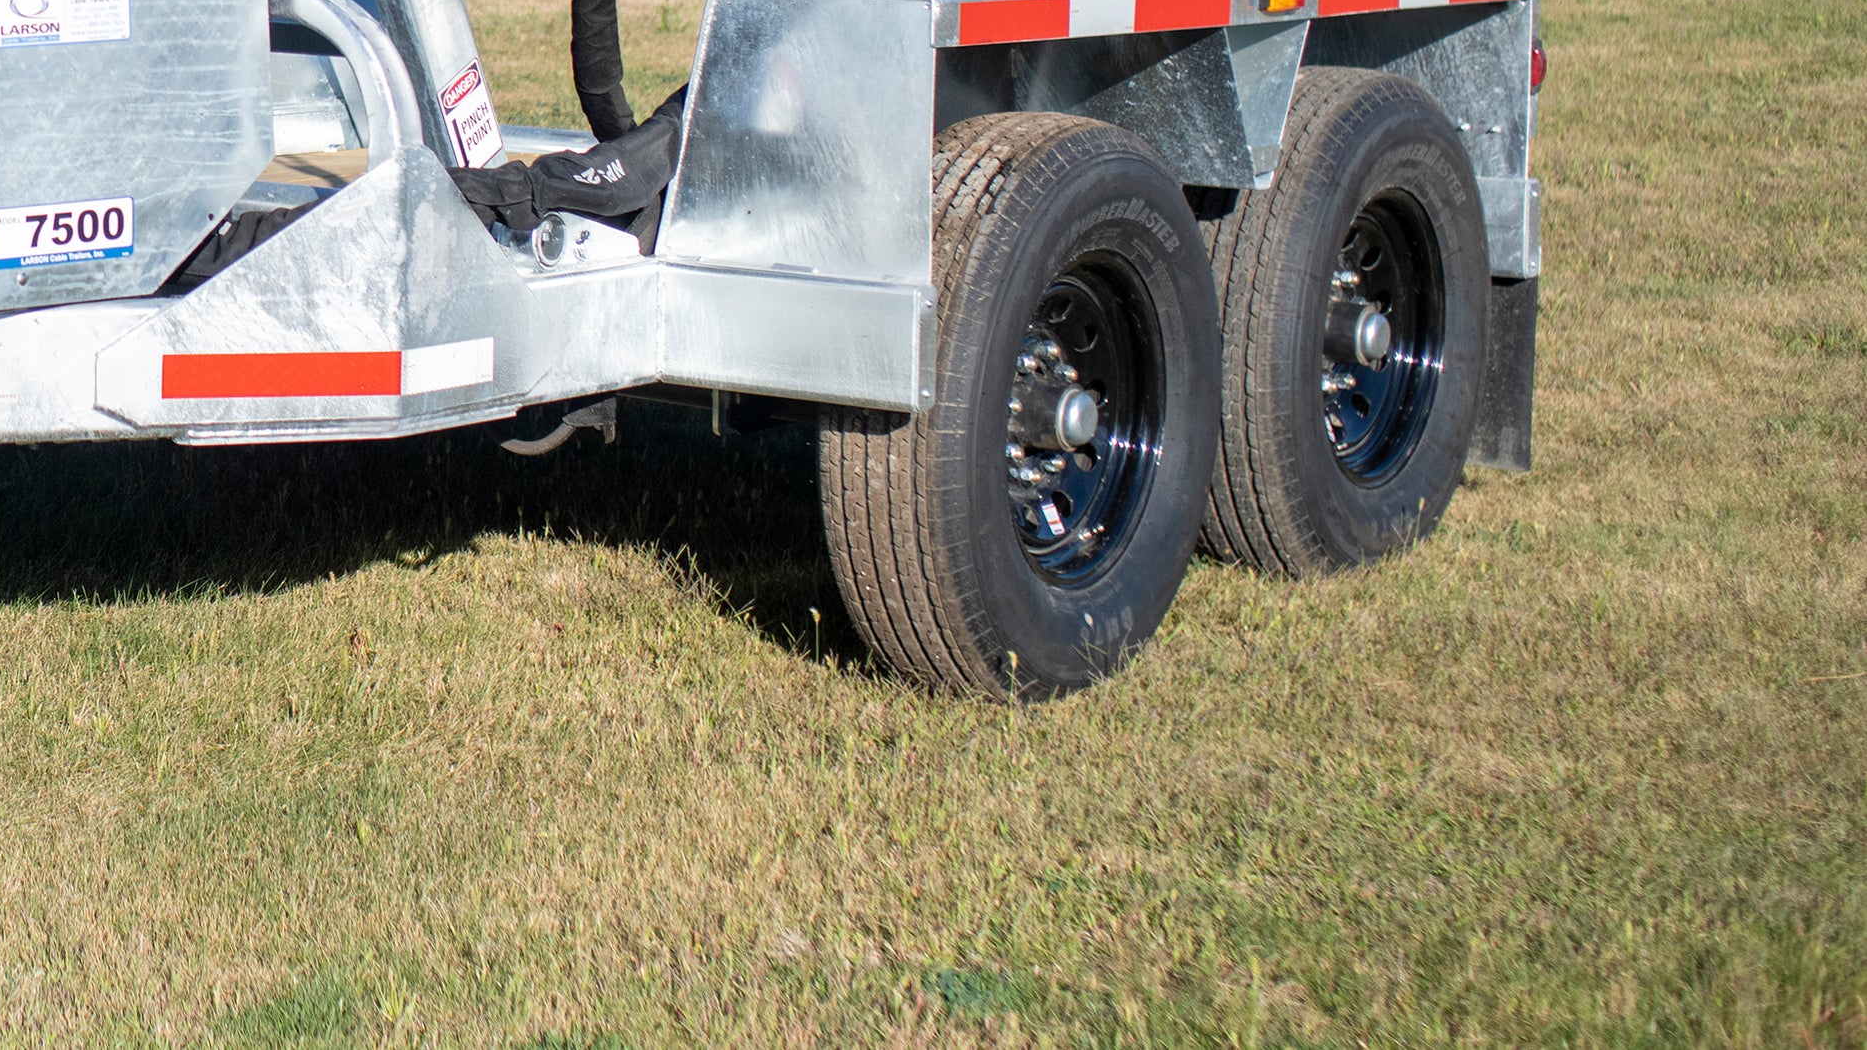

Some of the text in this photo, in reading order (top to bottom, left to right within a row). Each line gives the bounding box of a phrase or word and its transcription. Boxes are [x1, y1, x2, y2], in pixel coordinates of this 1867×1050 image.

[0, 22, 60, 36] LARSON
[445, 73, 476, 106] DANGER
[461, 102, 489, 135] PINCH
[466, 118, 492, 151] POINT
[25, 207, 125, 248] 7500
[20, 254, 50, 266] LARSON
[50, 253, 68, 263] Cable
